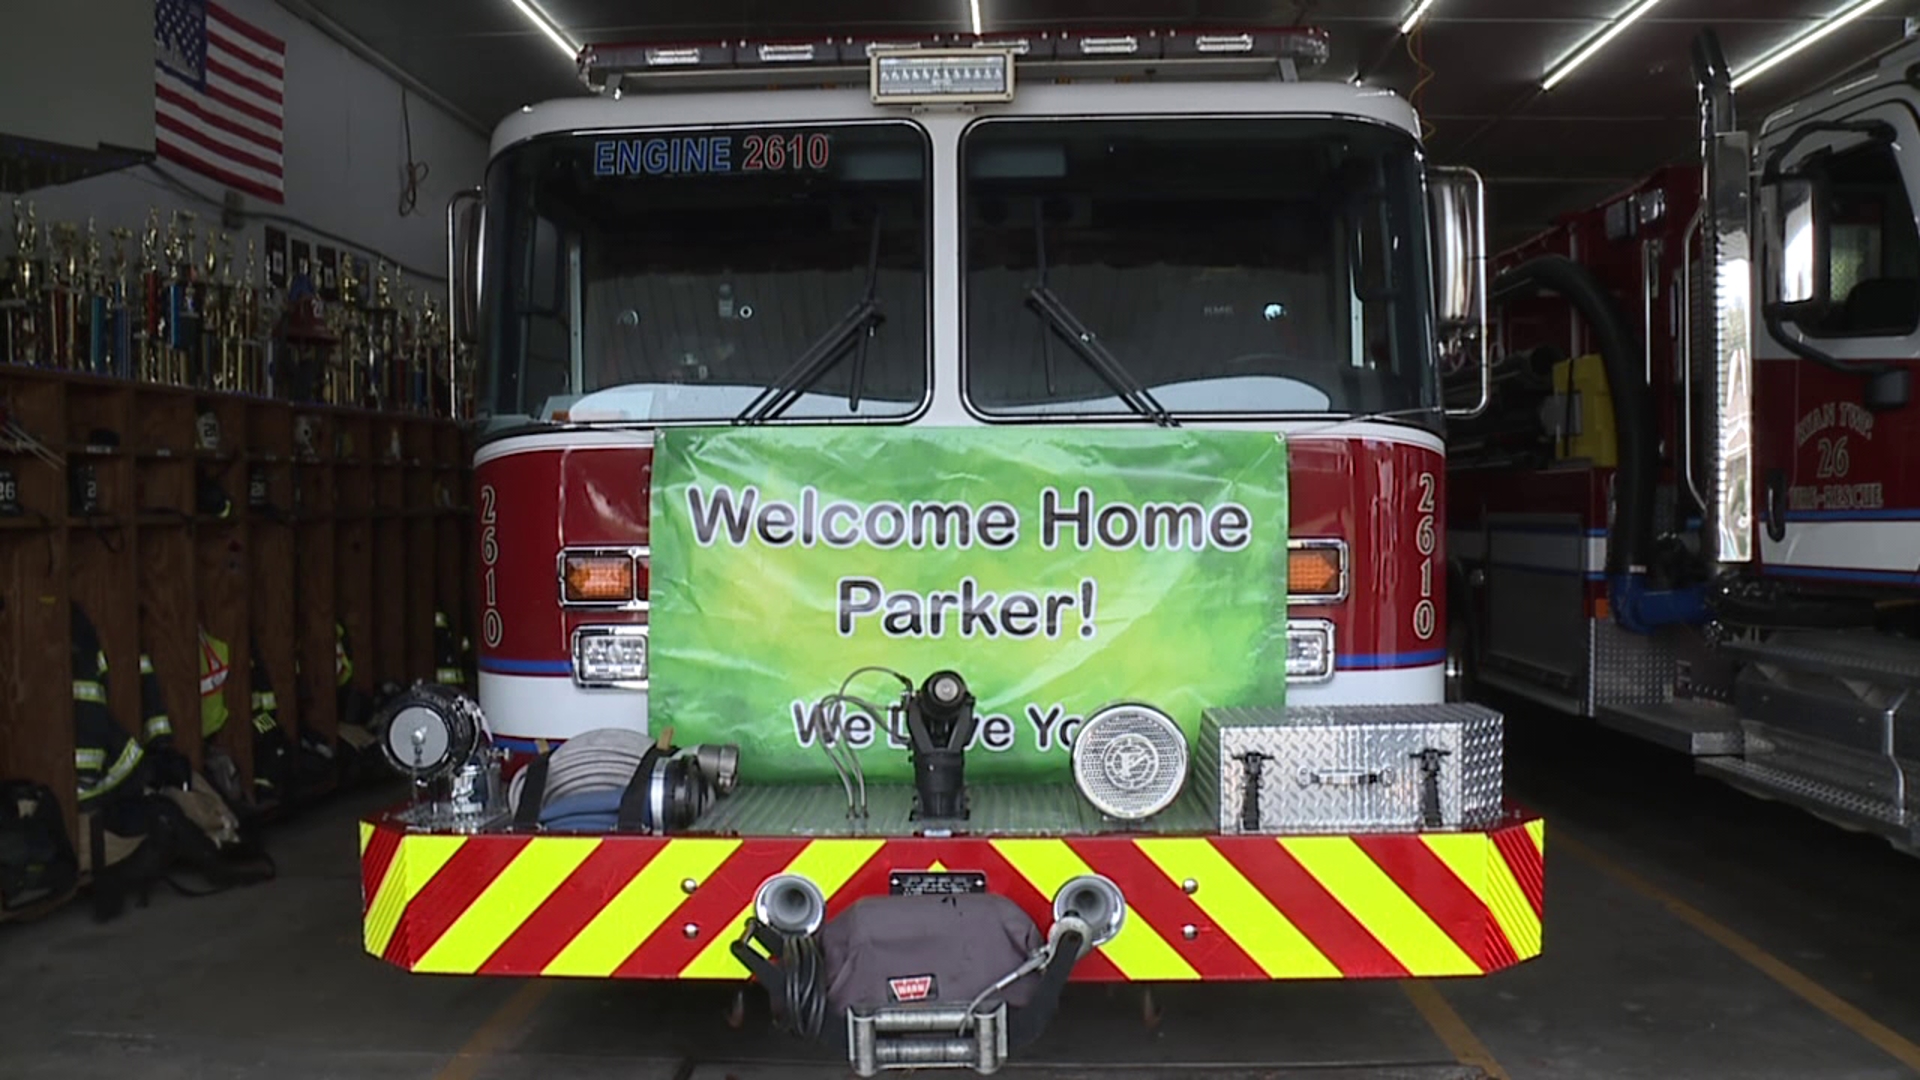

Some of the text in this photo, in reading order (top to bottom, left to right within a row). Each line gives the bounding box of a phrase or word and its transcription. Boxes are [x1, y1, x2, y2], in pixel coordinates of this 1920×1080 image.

[594, 133, 829, 175] ENGINE 2610
[1816, 436, 1850, 478] 26
[687, 485, 1249, 548] Welcome Home
[481, 485, 503, 648] 2610
[1413, 472, 1435, 640] 2610
[838, 579, 1097, 637] Parker!
[793, 701, 872, 746] We
